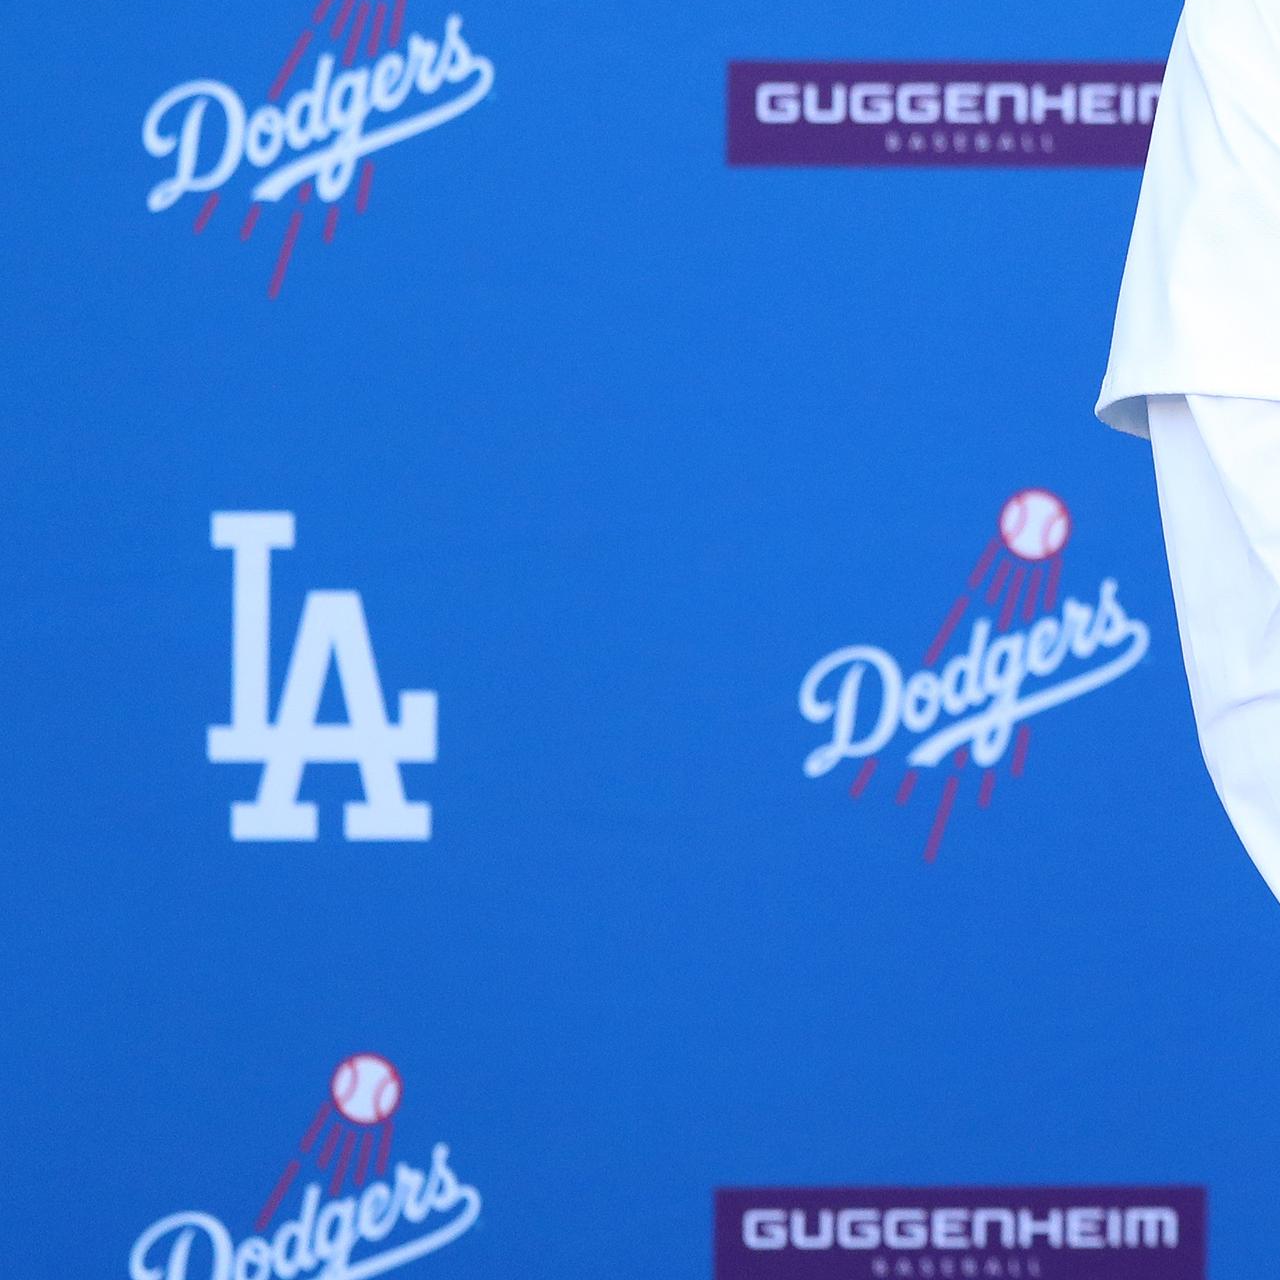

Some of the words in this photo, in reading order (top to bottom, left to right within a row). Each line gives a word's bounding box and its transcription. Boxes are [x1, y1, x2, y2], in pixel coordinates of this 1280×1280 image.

[142, 13, 495, 213] Dodgers
[206, 510, 439, 842] LA
[798, 578, 1151, 778] Dodgers
[742, 1206, 1179, 1251] GUGGENHEIM
